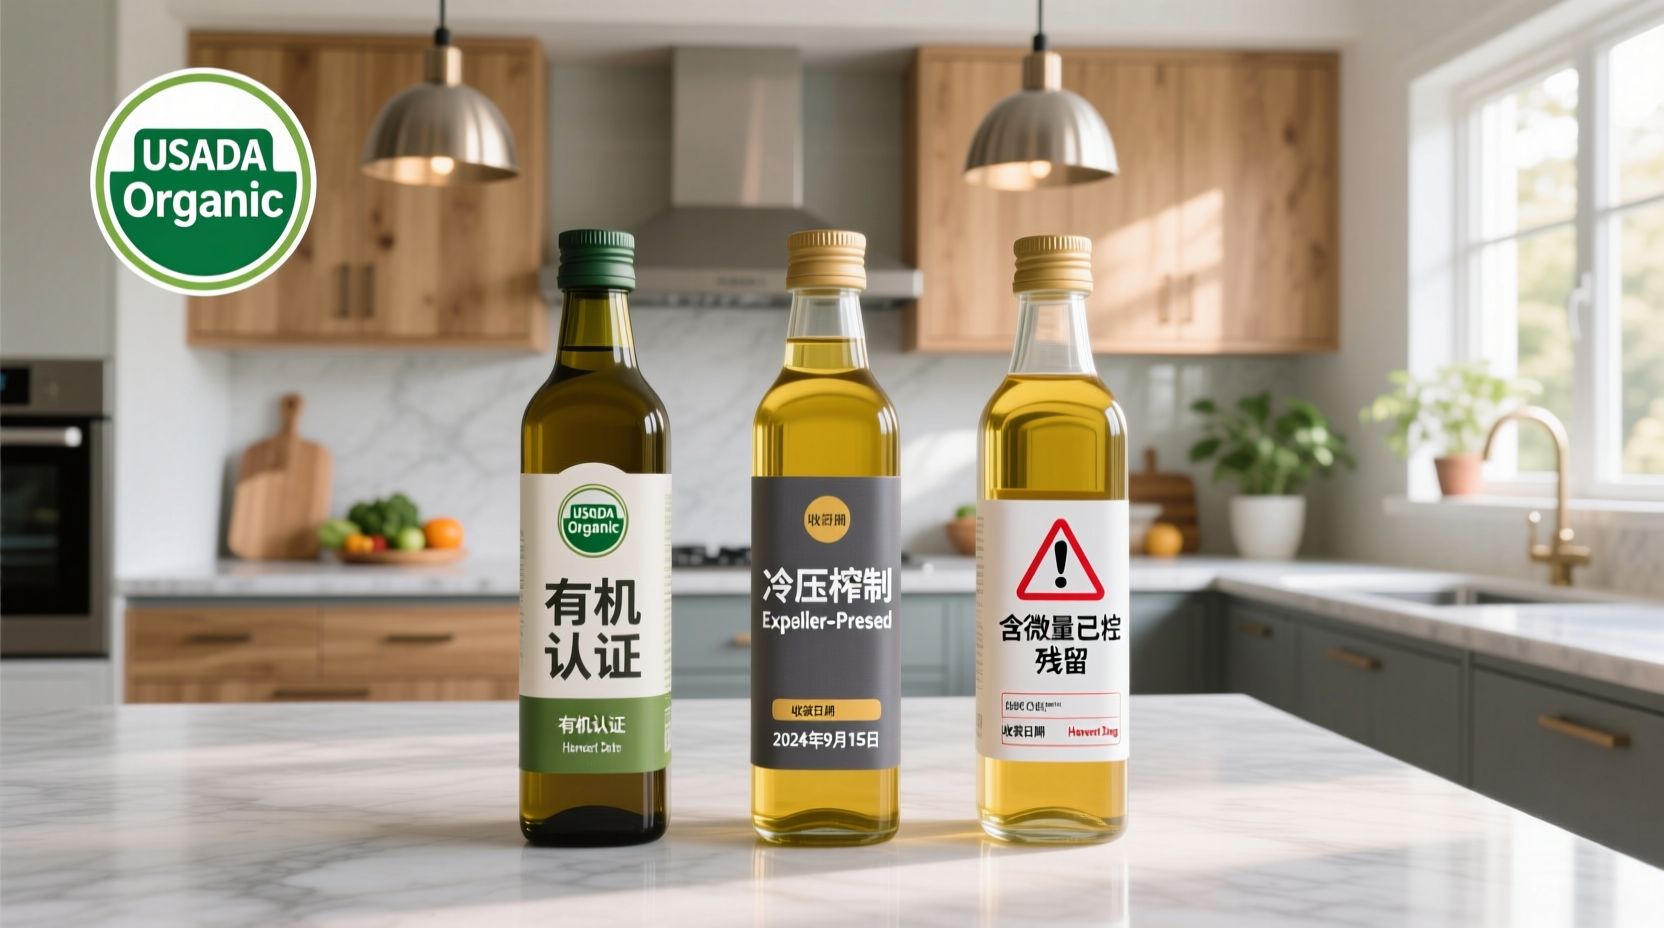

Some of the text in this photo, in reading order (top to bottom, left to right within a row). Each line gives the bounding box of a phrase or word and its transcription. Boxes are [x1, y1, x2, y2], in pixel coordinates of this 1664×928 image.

[567, 520, 620, 538] Organic
[762, 566, 893, 604] 冷压榨制
[544, 577, 642, 626] 有机
[544, 631, 642, 681] 认证
[1034, 644, 1088, 675] 残留
[558, 714, 627, 735] 有机认证
[772, 730, 880, 751] 2024年9月15日
